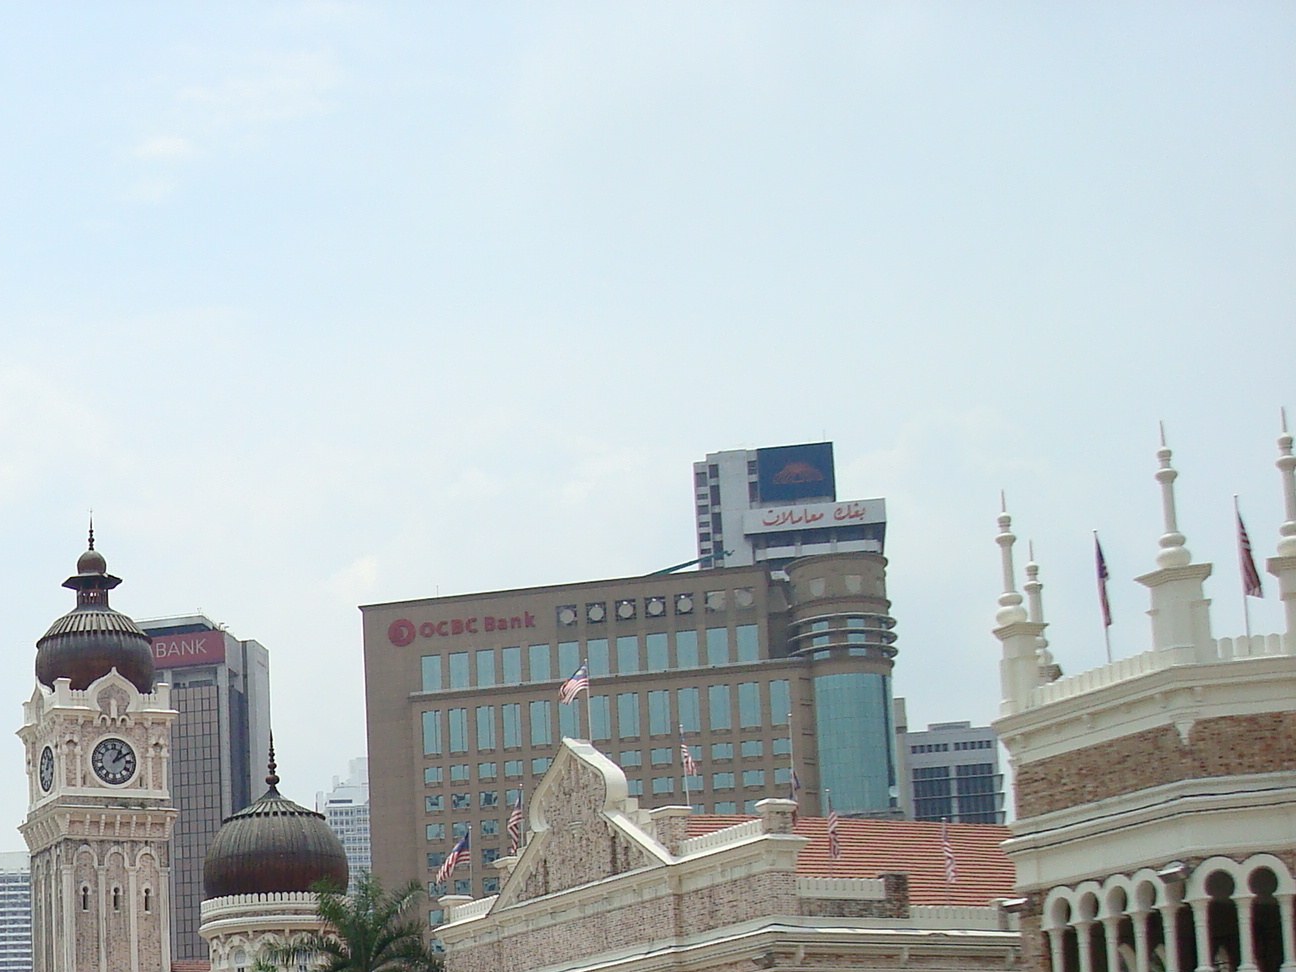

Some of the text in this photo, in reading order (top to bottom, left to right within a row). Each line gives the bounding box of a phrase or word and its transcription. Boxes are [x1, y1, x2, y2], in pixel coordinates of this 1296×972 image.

[419, 611, 536, 638] OCBC Bank
[156, 638, 207, 658] BANK
